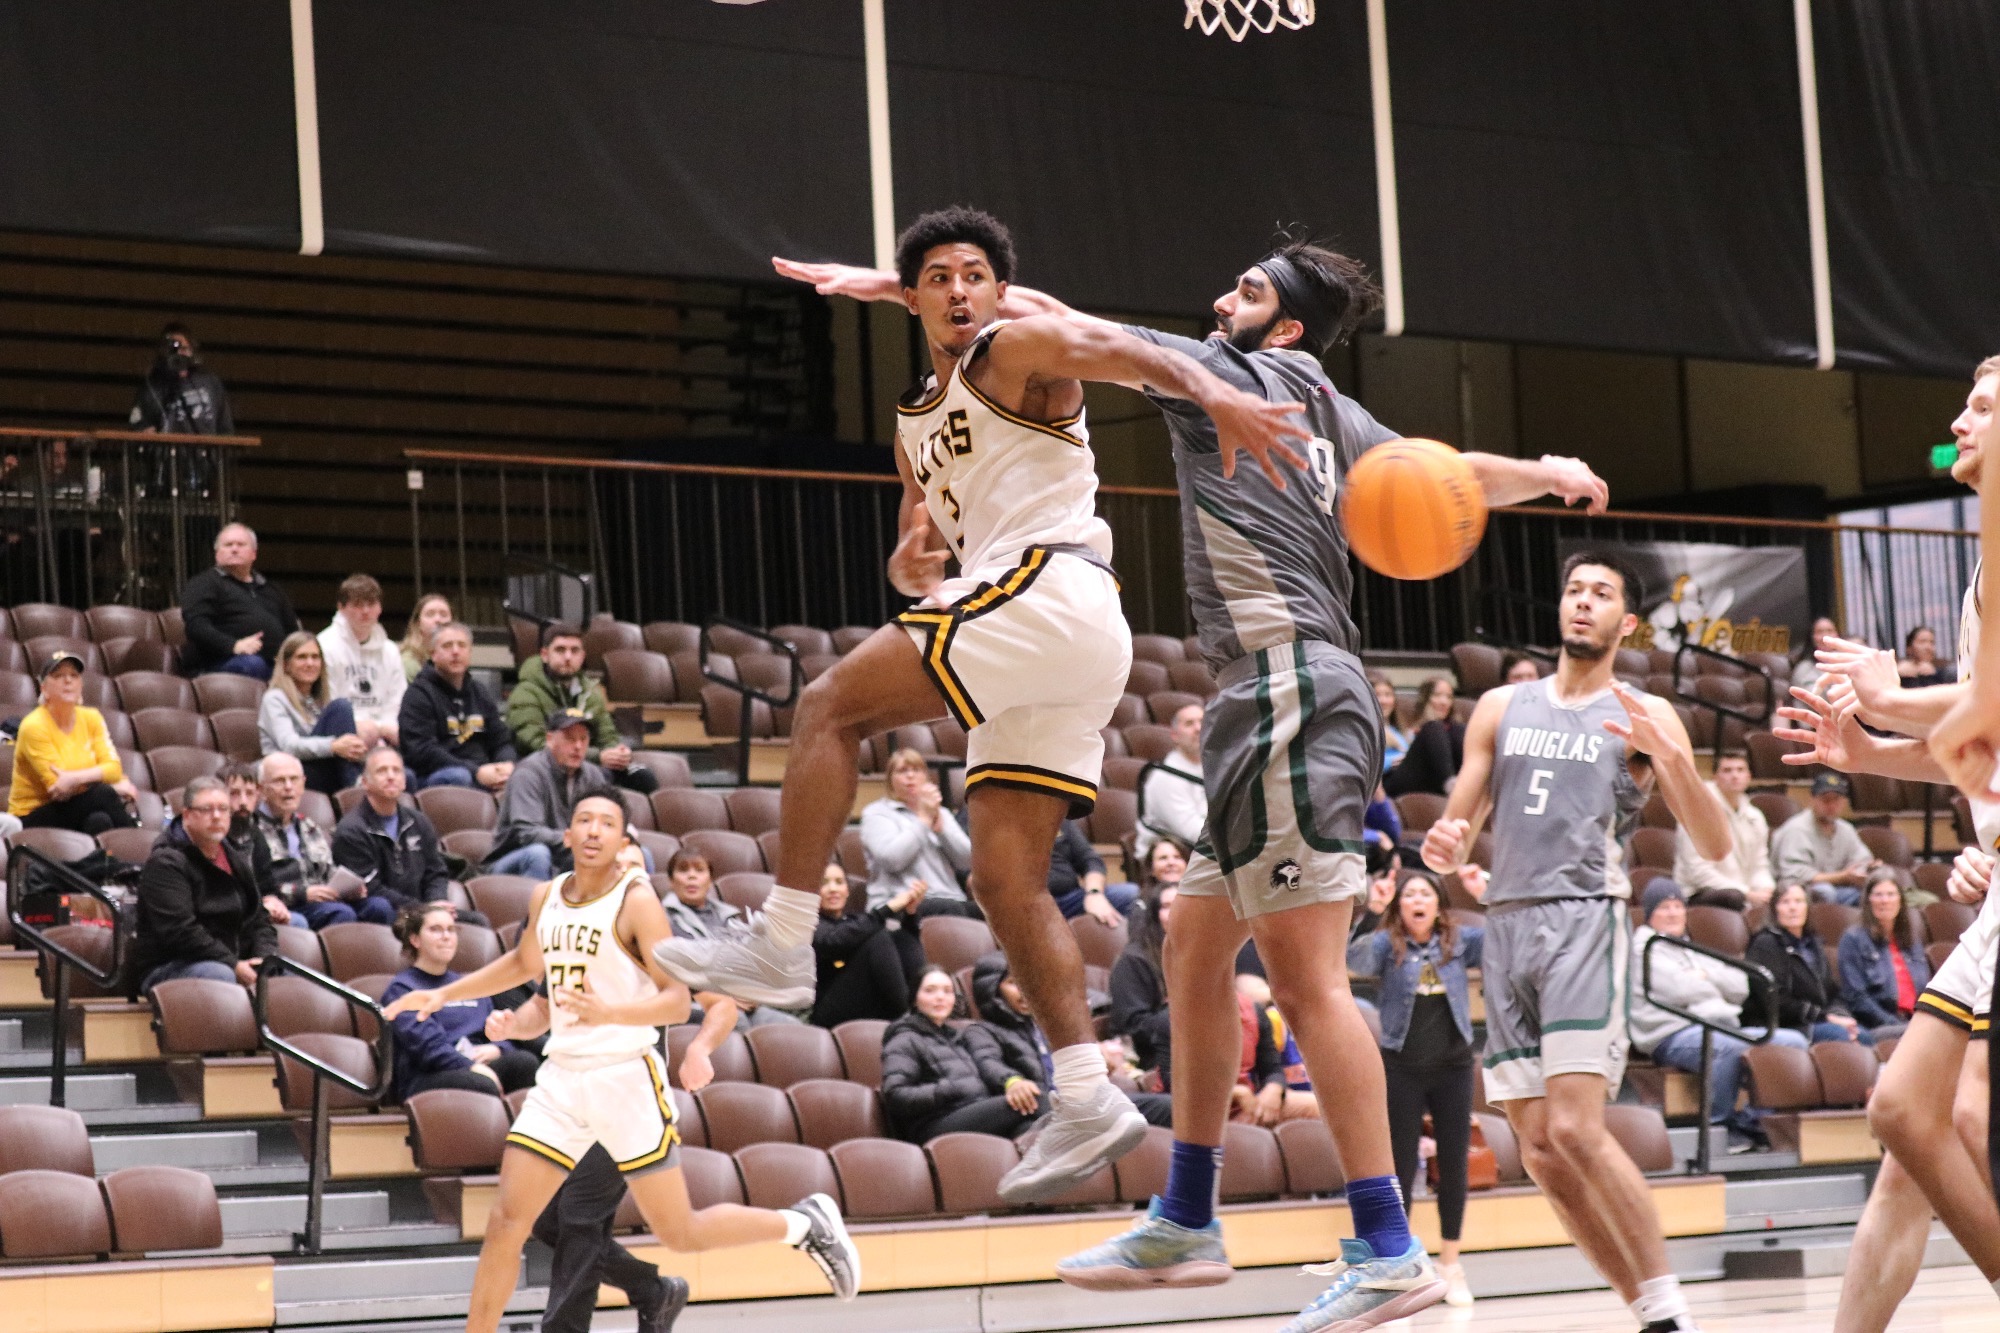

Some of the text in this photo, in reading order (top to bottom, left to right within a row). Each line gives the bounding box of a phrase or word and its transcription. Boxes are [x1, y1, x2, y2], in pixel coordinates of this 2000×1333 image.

[1503, 726, 1604, 763] DOUGLAS
[1523, 768, 1555, 816] 5
[540, 924, 602, 956] LUTES
